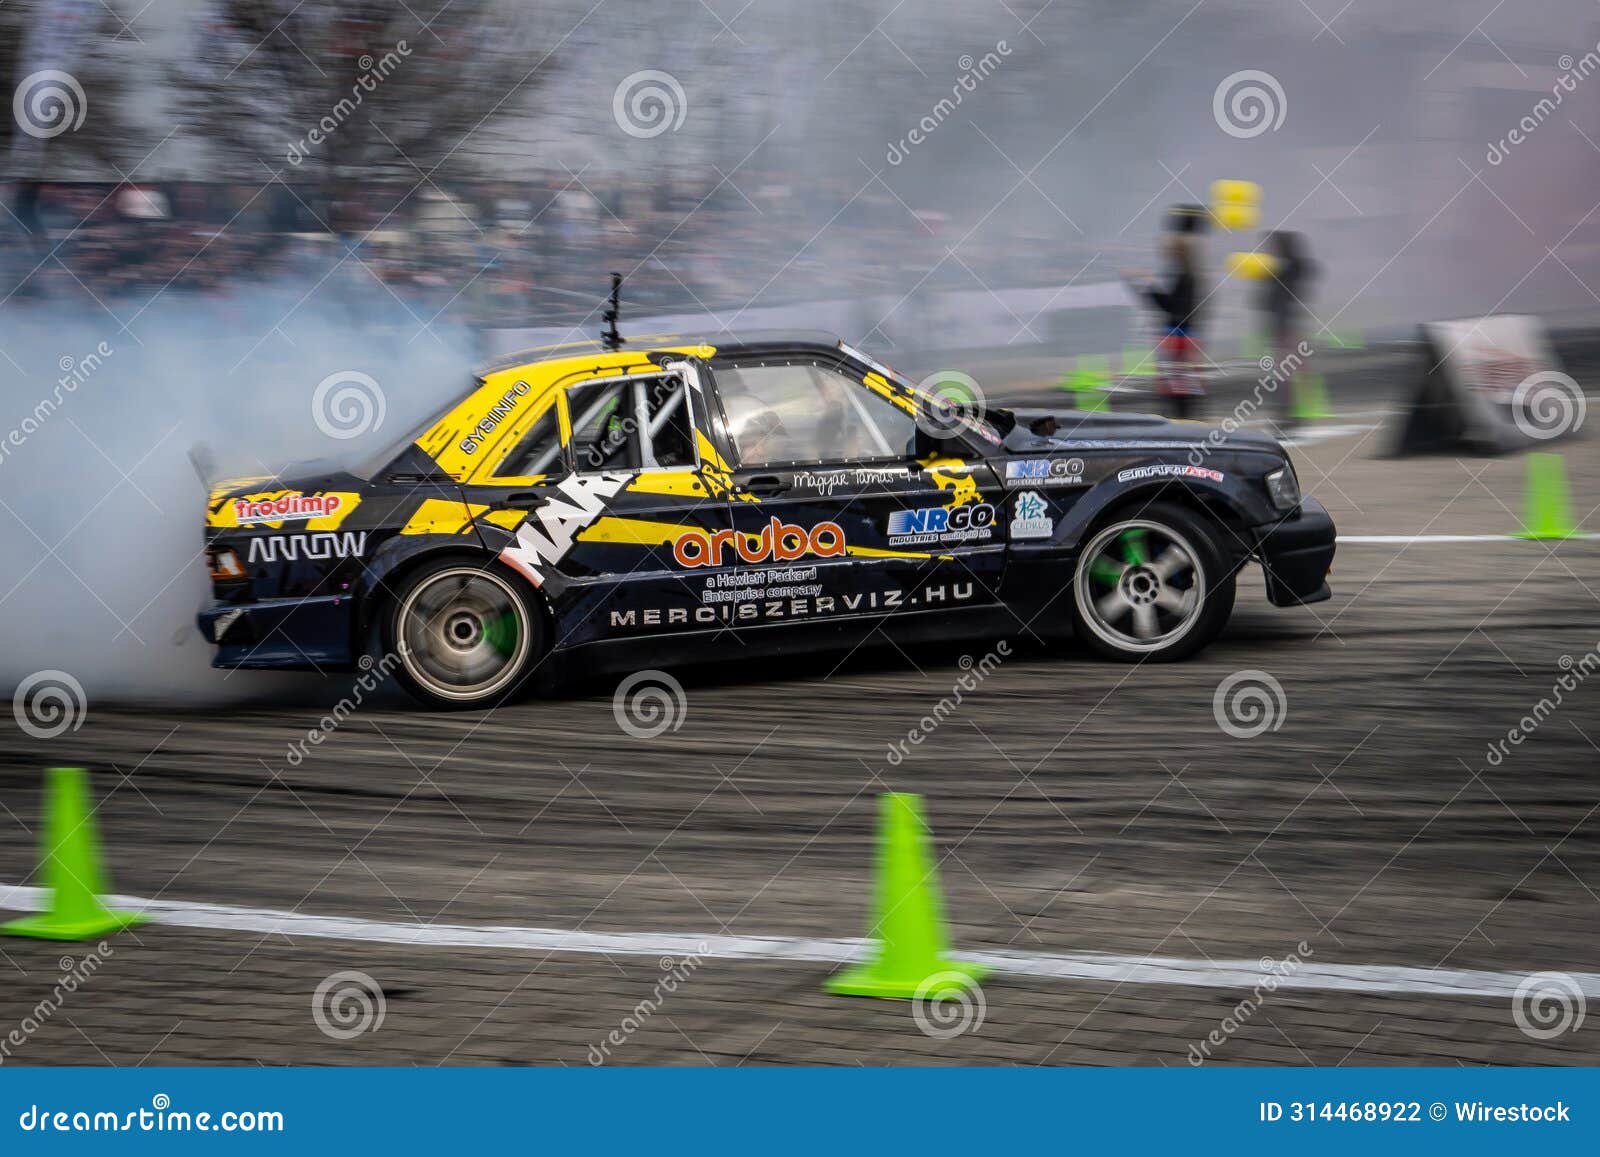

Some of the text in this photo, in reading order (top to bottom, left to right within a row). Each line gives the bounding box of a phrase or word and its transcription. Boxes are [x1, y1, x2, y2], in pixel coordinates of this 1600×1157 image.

[459, 380, 532, 455] SYSINFO
[234, 494, 341, 518] trodimp
[887, 503, 995, 535] NRGO
[248, 531, 366, 563] ARROW
[673, 516, 847, 568] aruba
[702, 584, 823, 603] Enterprise company
[706, 567, 817, 588] a Hewlett Packard
[610, 581, 974, 627] MERCISZERVIZ.HU
